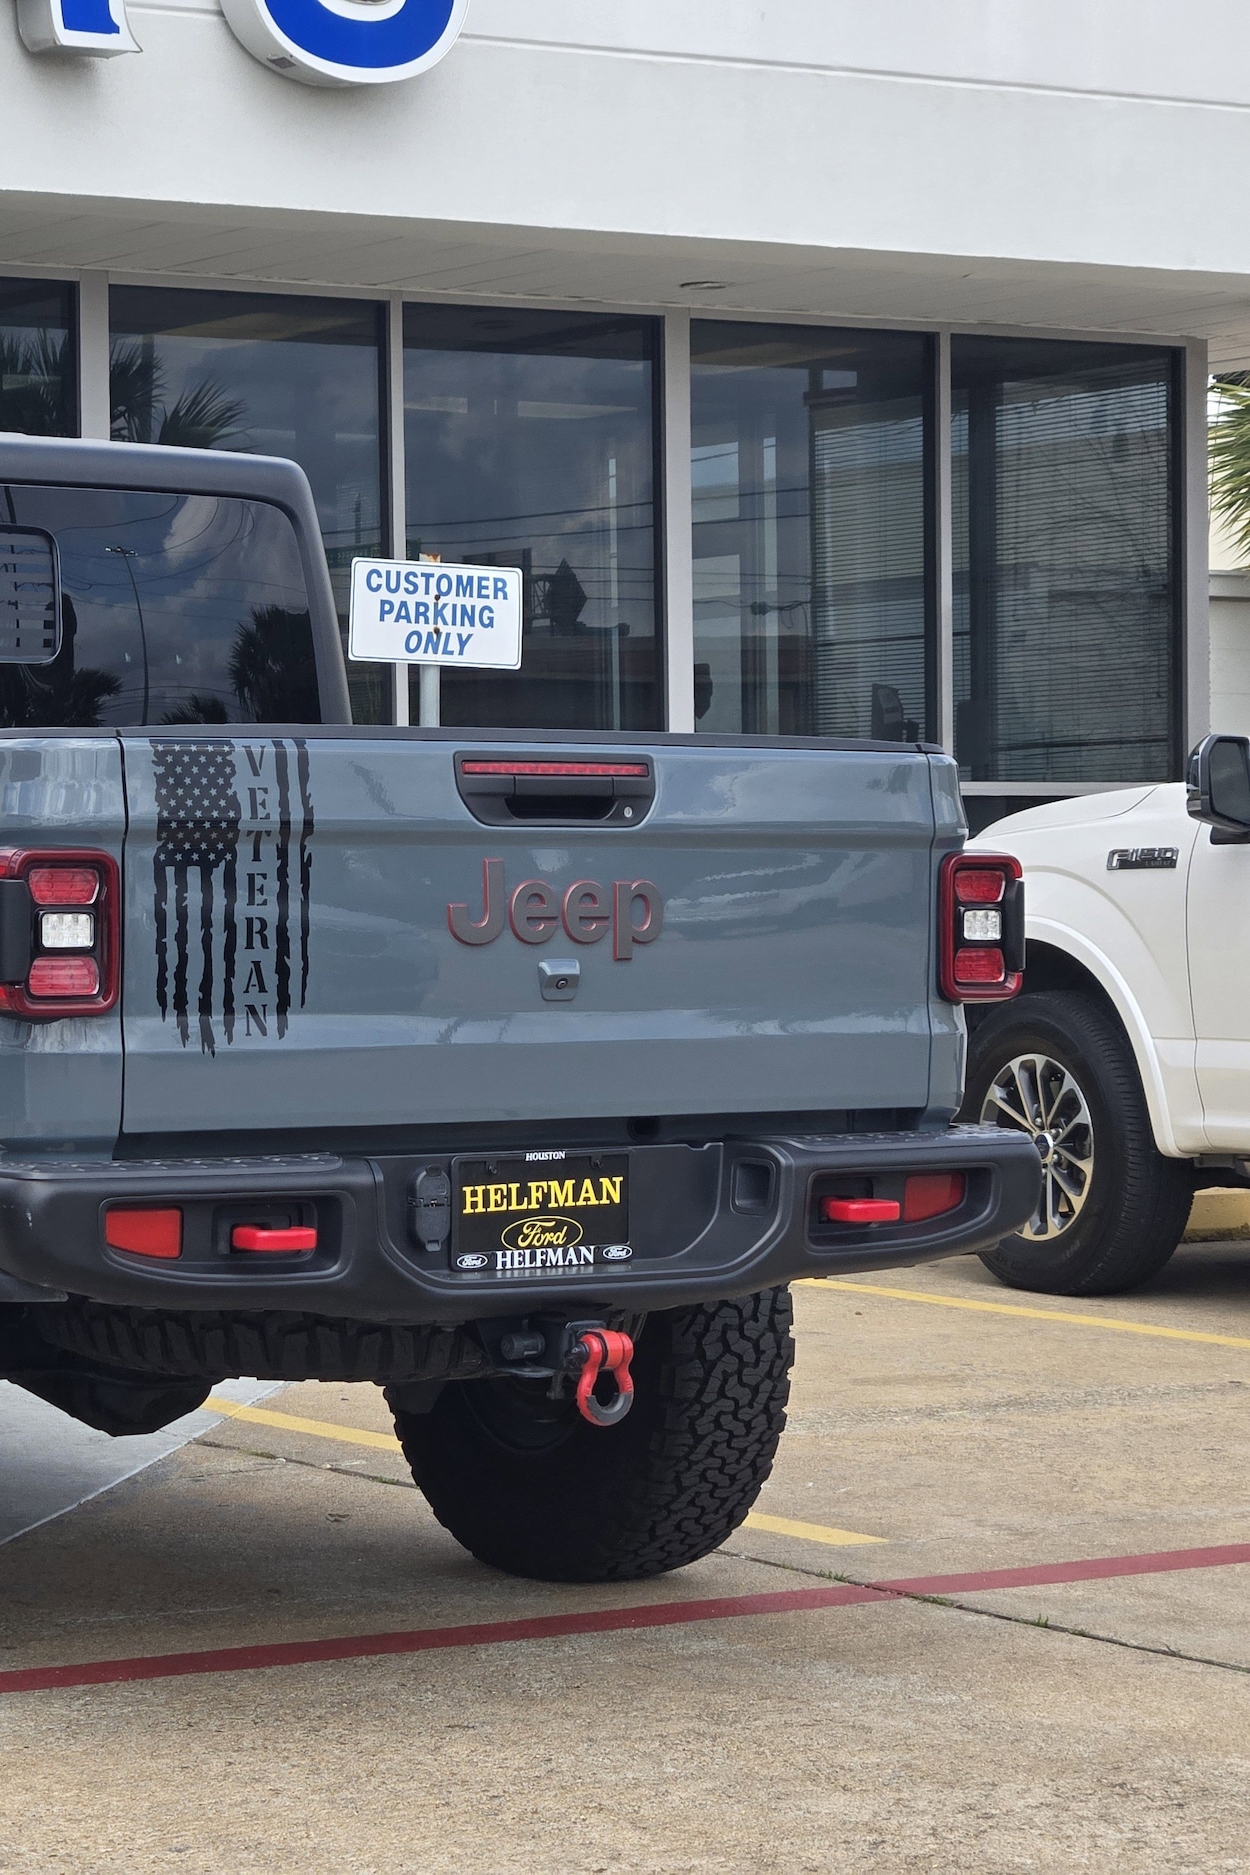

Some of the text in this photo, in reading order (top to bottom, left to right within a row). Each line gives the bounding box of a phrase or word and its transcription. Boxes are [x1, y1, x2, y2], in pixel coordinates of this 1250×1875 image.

[366, 568, 509, 600] CUSTOMER
[379, 599, 495, 628] PARKING
[404, 630, 474, 656] ONLY
[241, 745, 273, 1038] VETERAN
[447, 858, 664, 961] Jeep
[525, 1151, 566, 1161] HOUSTON
[462, 1176, 624, 1214] HELFMAN
[517, 1220, 568, 1248] Ford
[495, 1246, 595, 1270] HELFMAN
